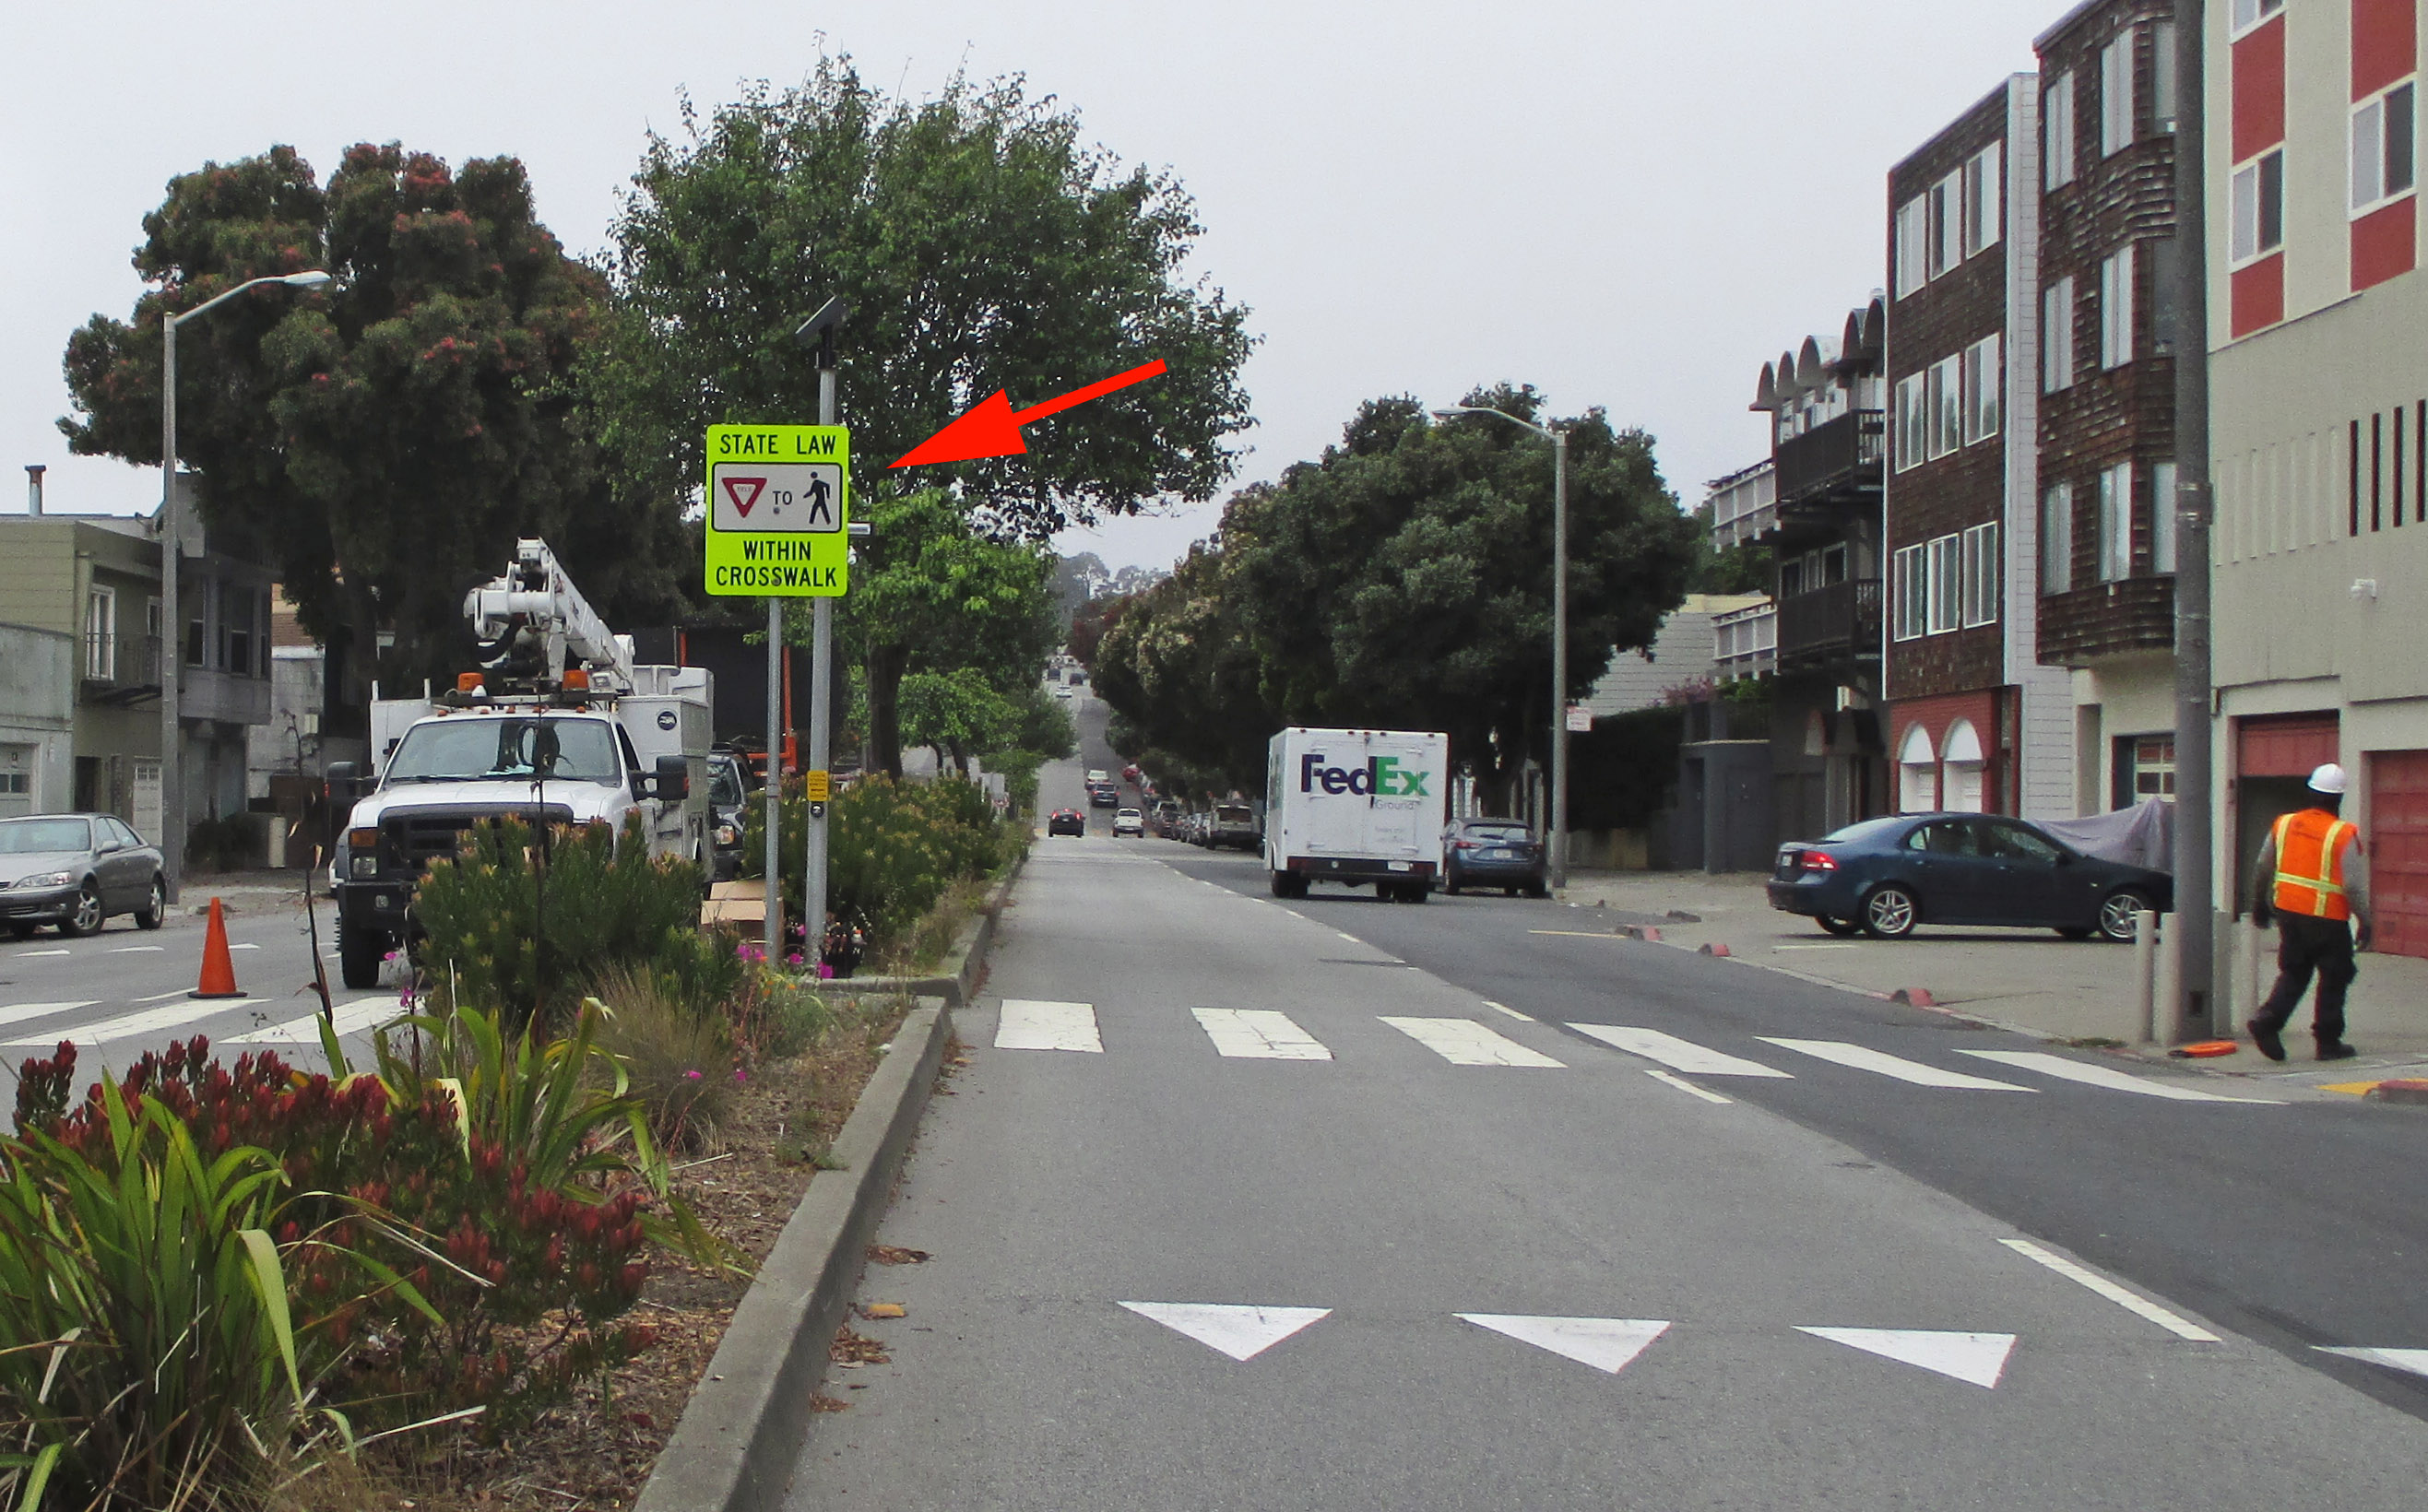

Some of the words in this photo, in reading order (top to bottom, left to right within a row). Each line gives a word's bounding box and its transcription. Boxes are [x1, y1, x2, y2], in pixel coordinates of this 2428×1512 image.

[720, 434, 778, 454] STATE
[797, 435, 836, 455] LAW
[773, 490, 792, 505] TO
[743, 540, 811, 561] WITHIN
[716, 566, 836, 587] CROSSWALK
[1300, 753, 1430, 796] FedEx
[1375, 798, 1415, 810] Ground
